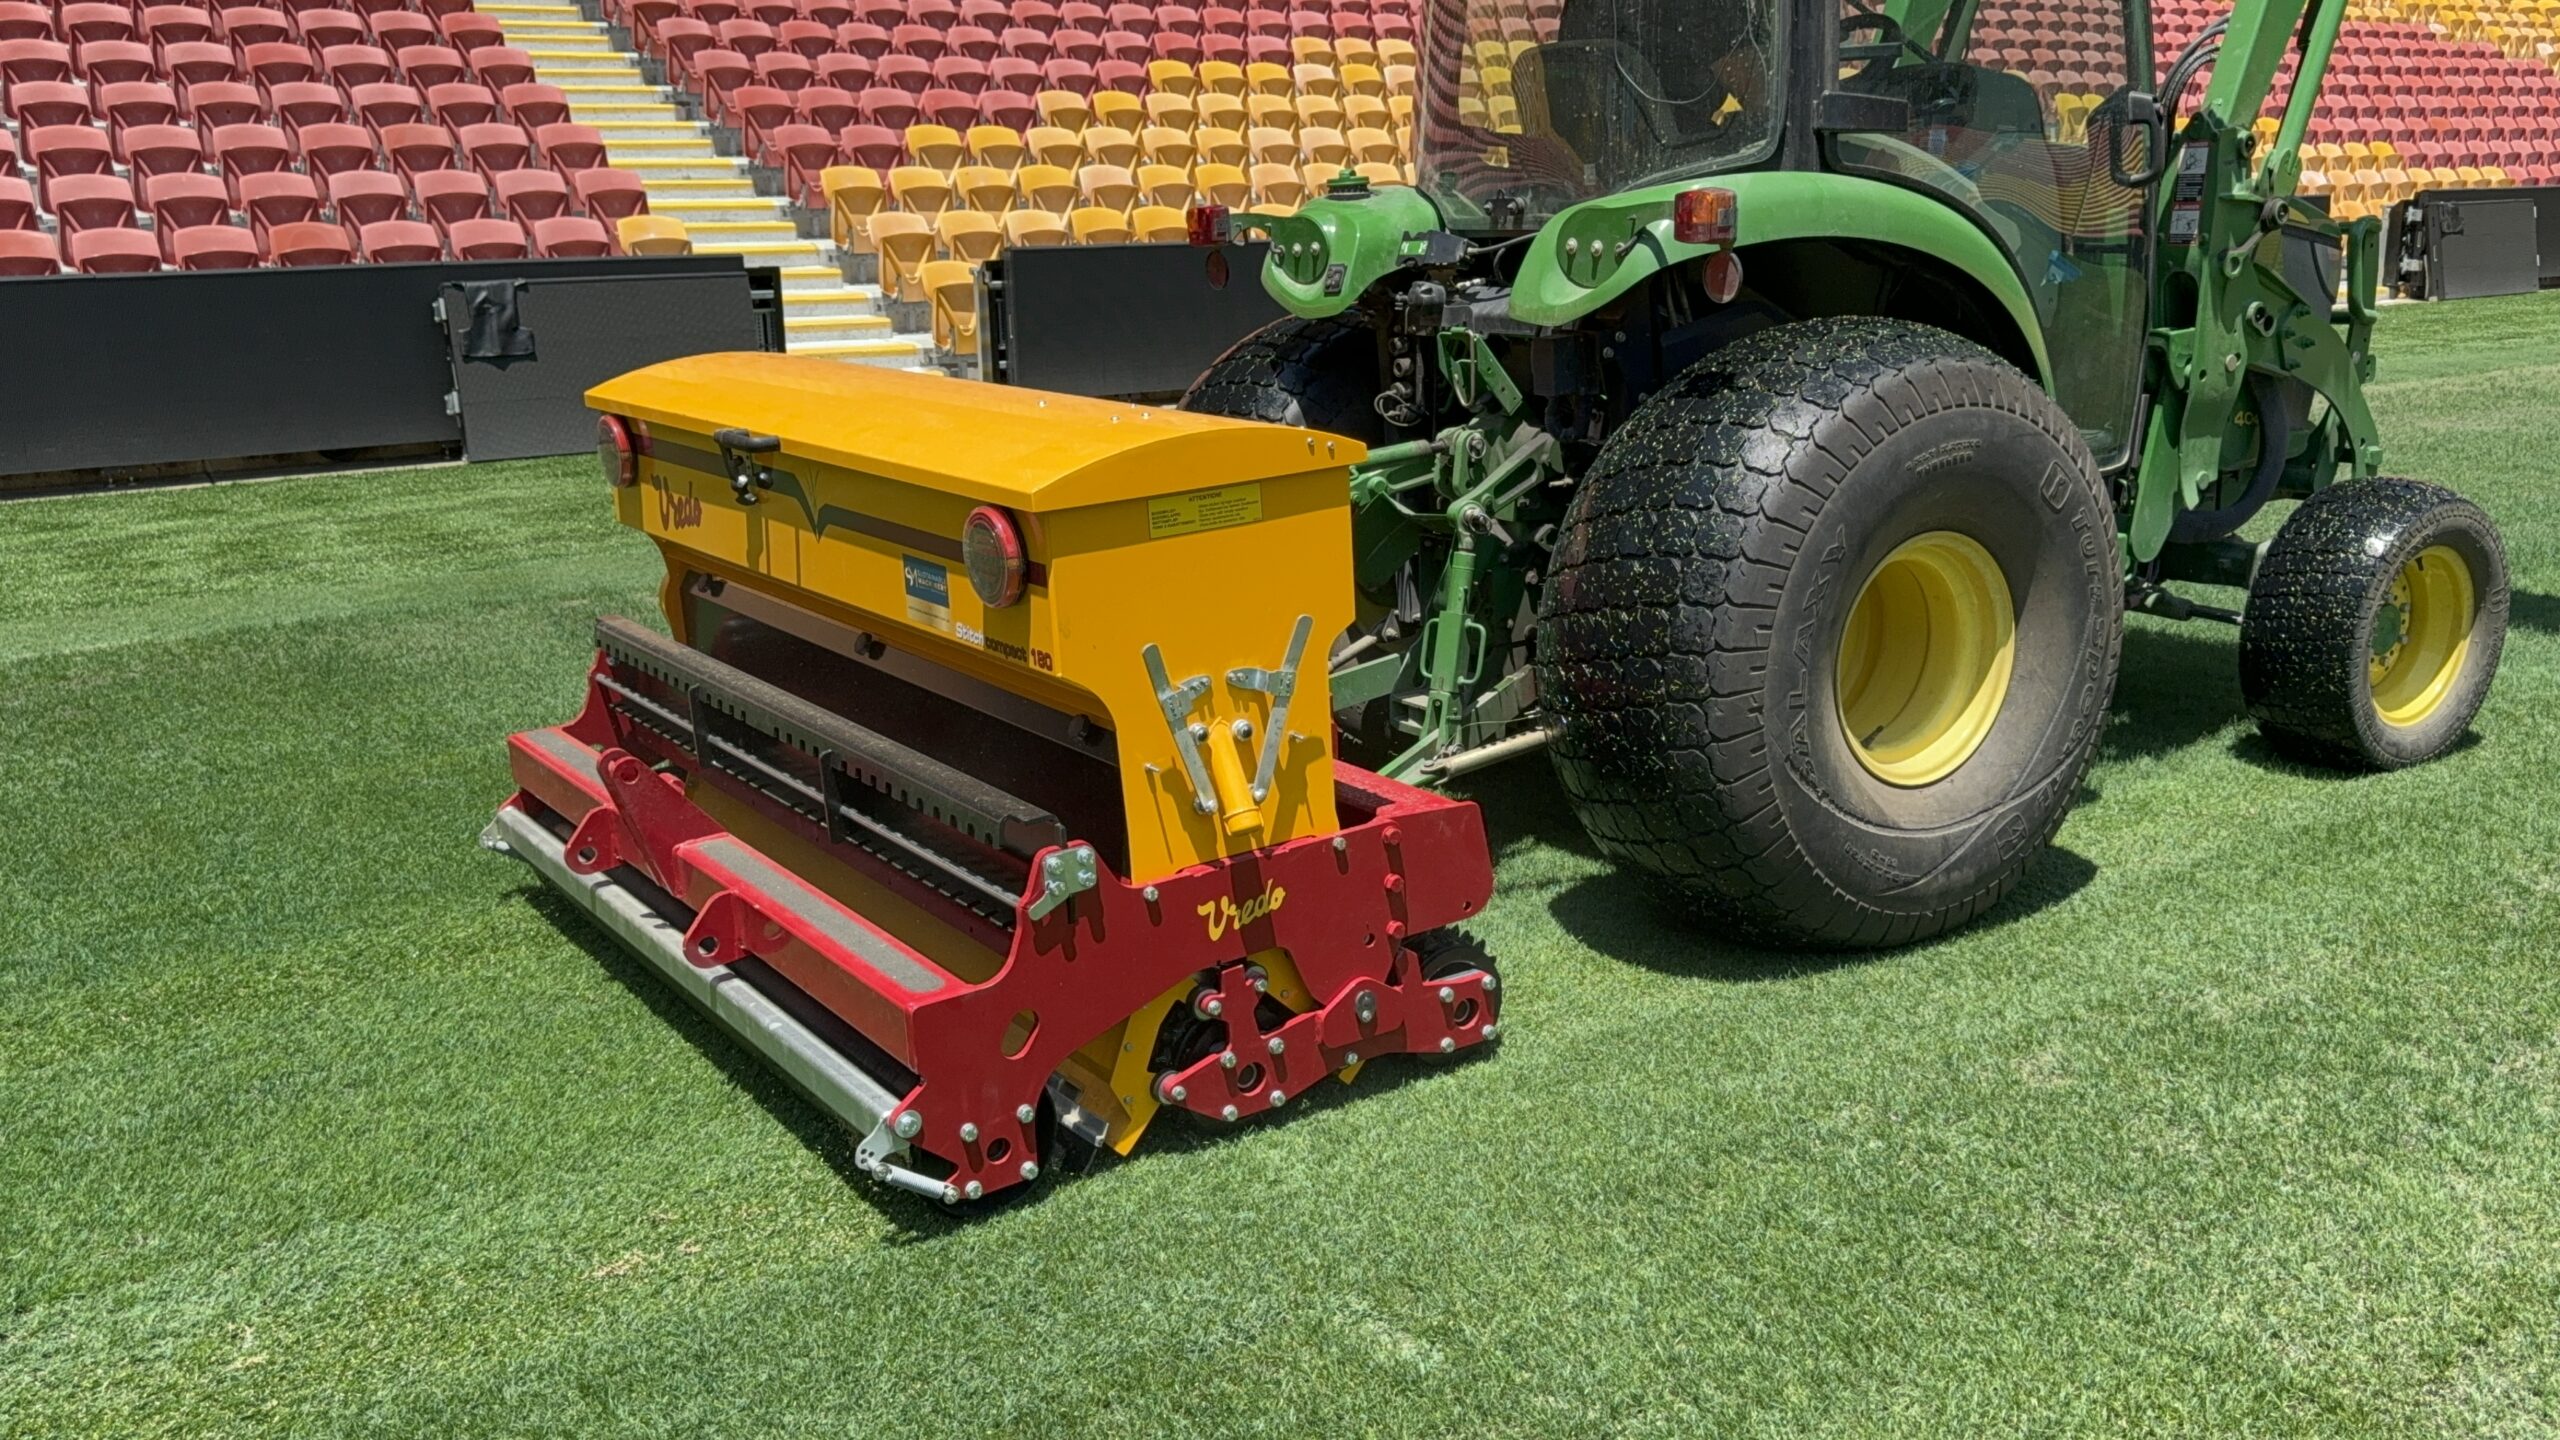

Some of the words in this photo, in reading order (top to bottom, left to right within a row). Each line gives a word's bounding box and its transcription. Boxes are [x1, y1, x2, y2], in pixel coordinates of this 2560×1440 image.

[650, 473, 703, 532] Vredo
[1030, 647, 1054, 672] 180
[1197, 878, 1286, 941] Vredo
